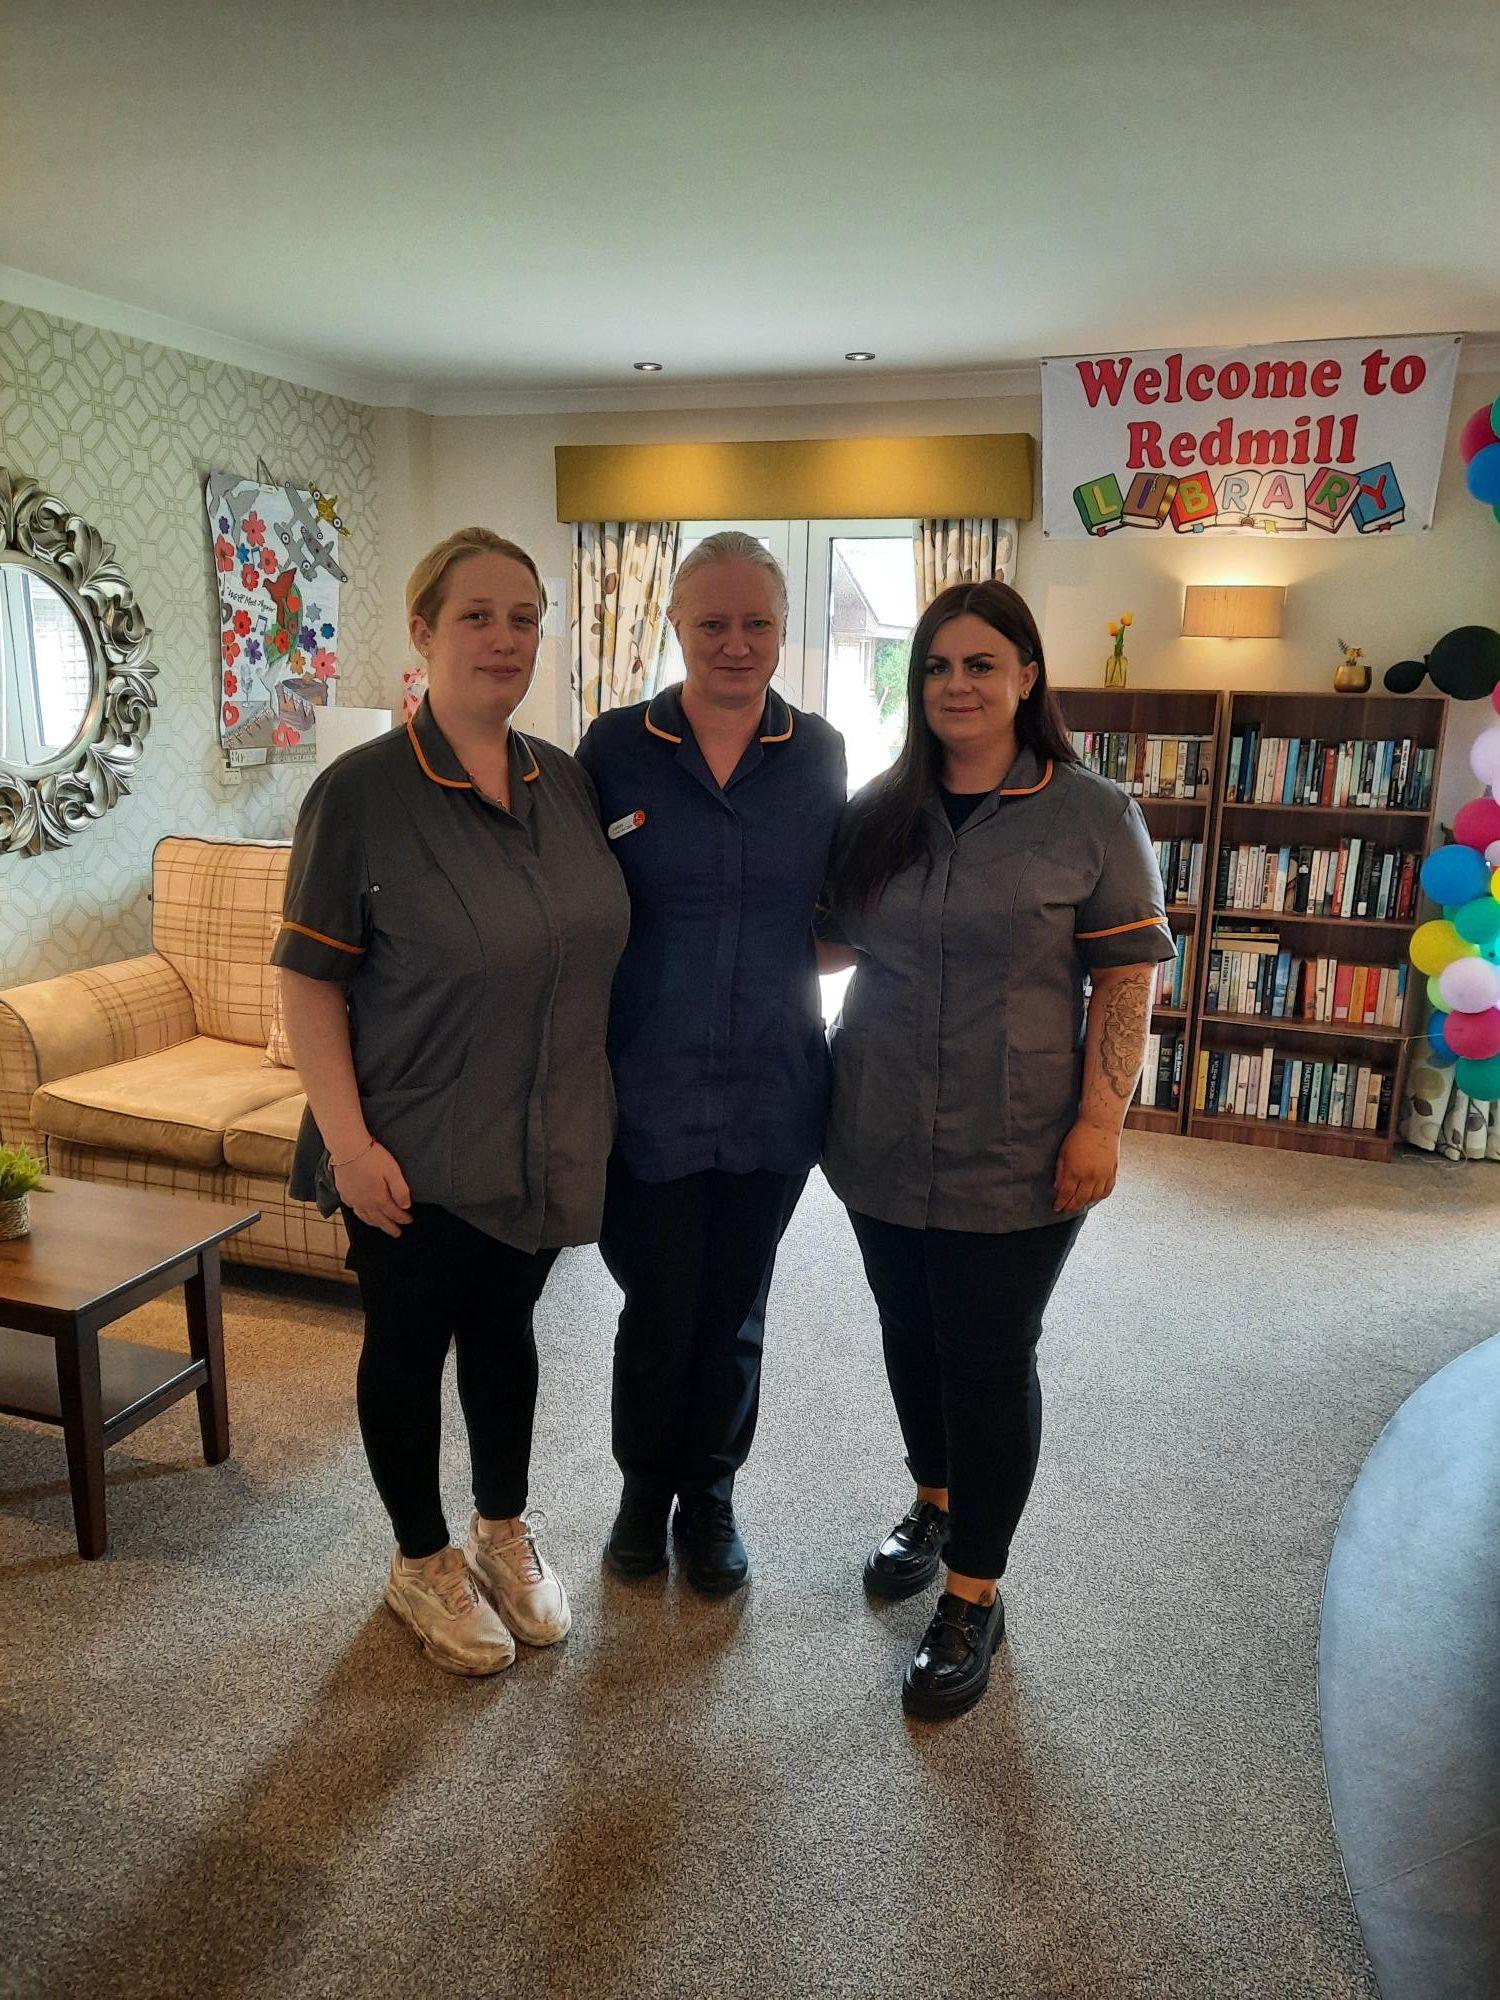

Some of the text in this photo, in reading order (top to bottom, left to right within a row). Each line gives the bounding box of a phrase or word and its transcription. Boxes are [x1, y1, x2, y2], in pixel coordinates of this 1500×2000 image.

[1076, 349, 1427, 408] Welcome to
[1125, 414, 1360, 469] Redmill
